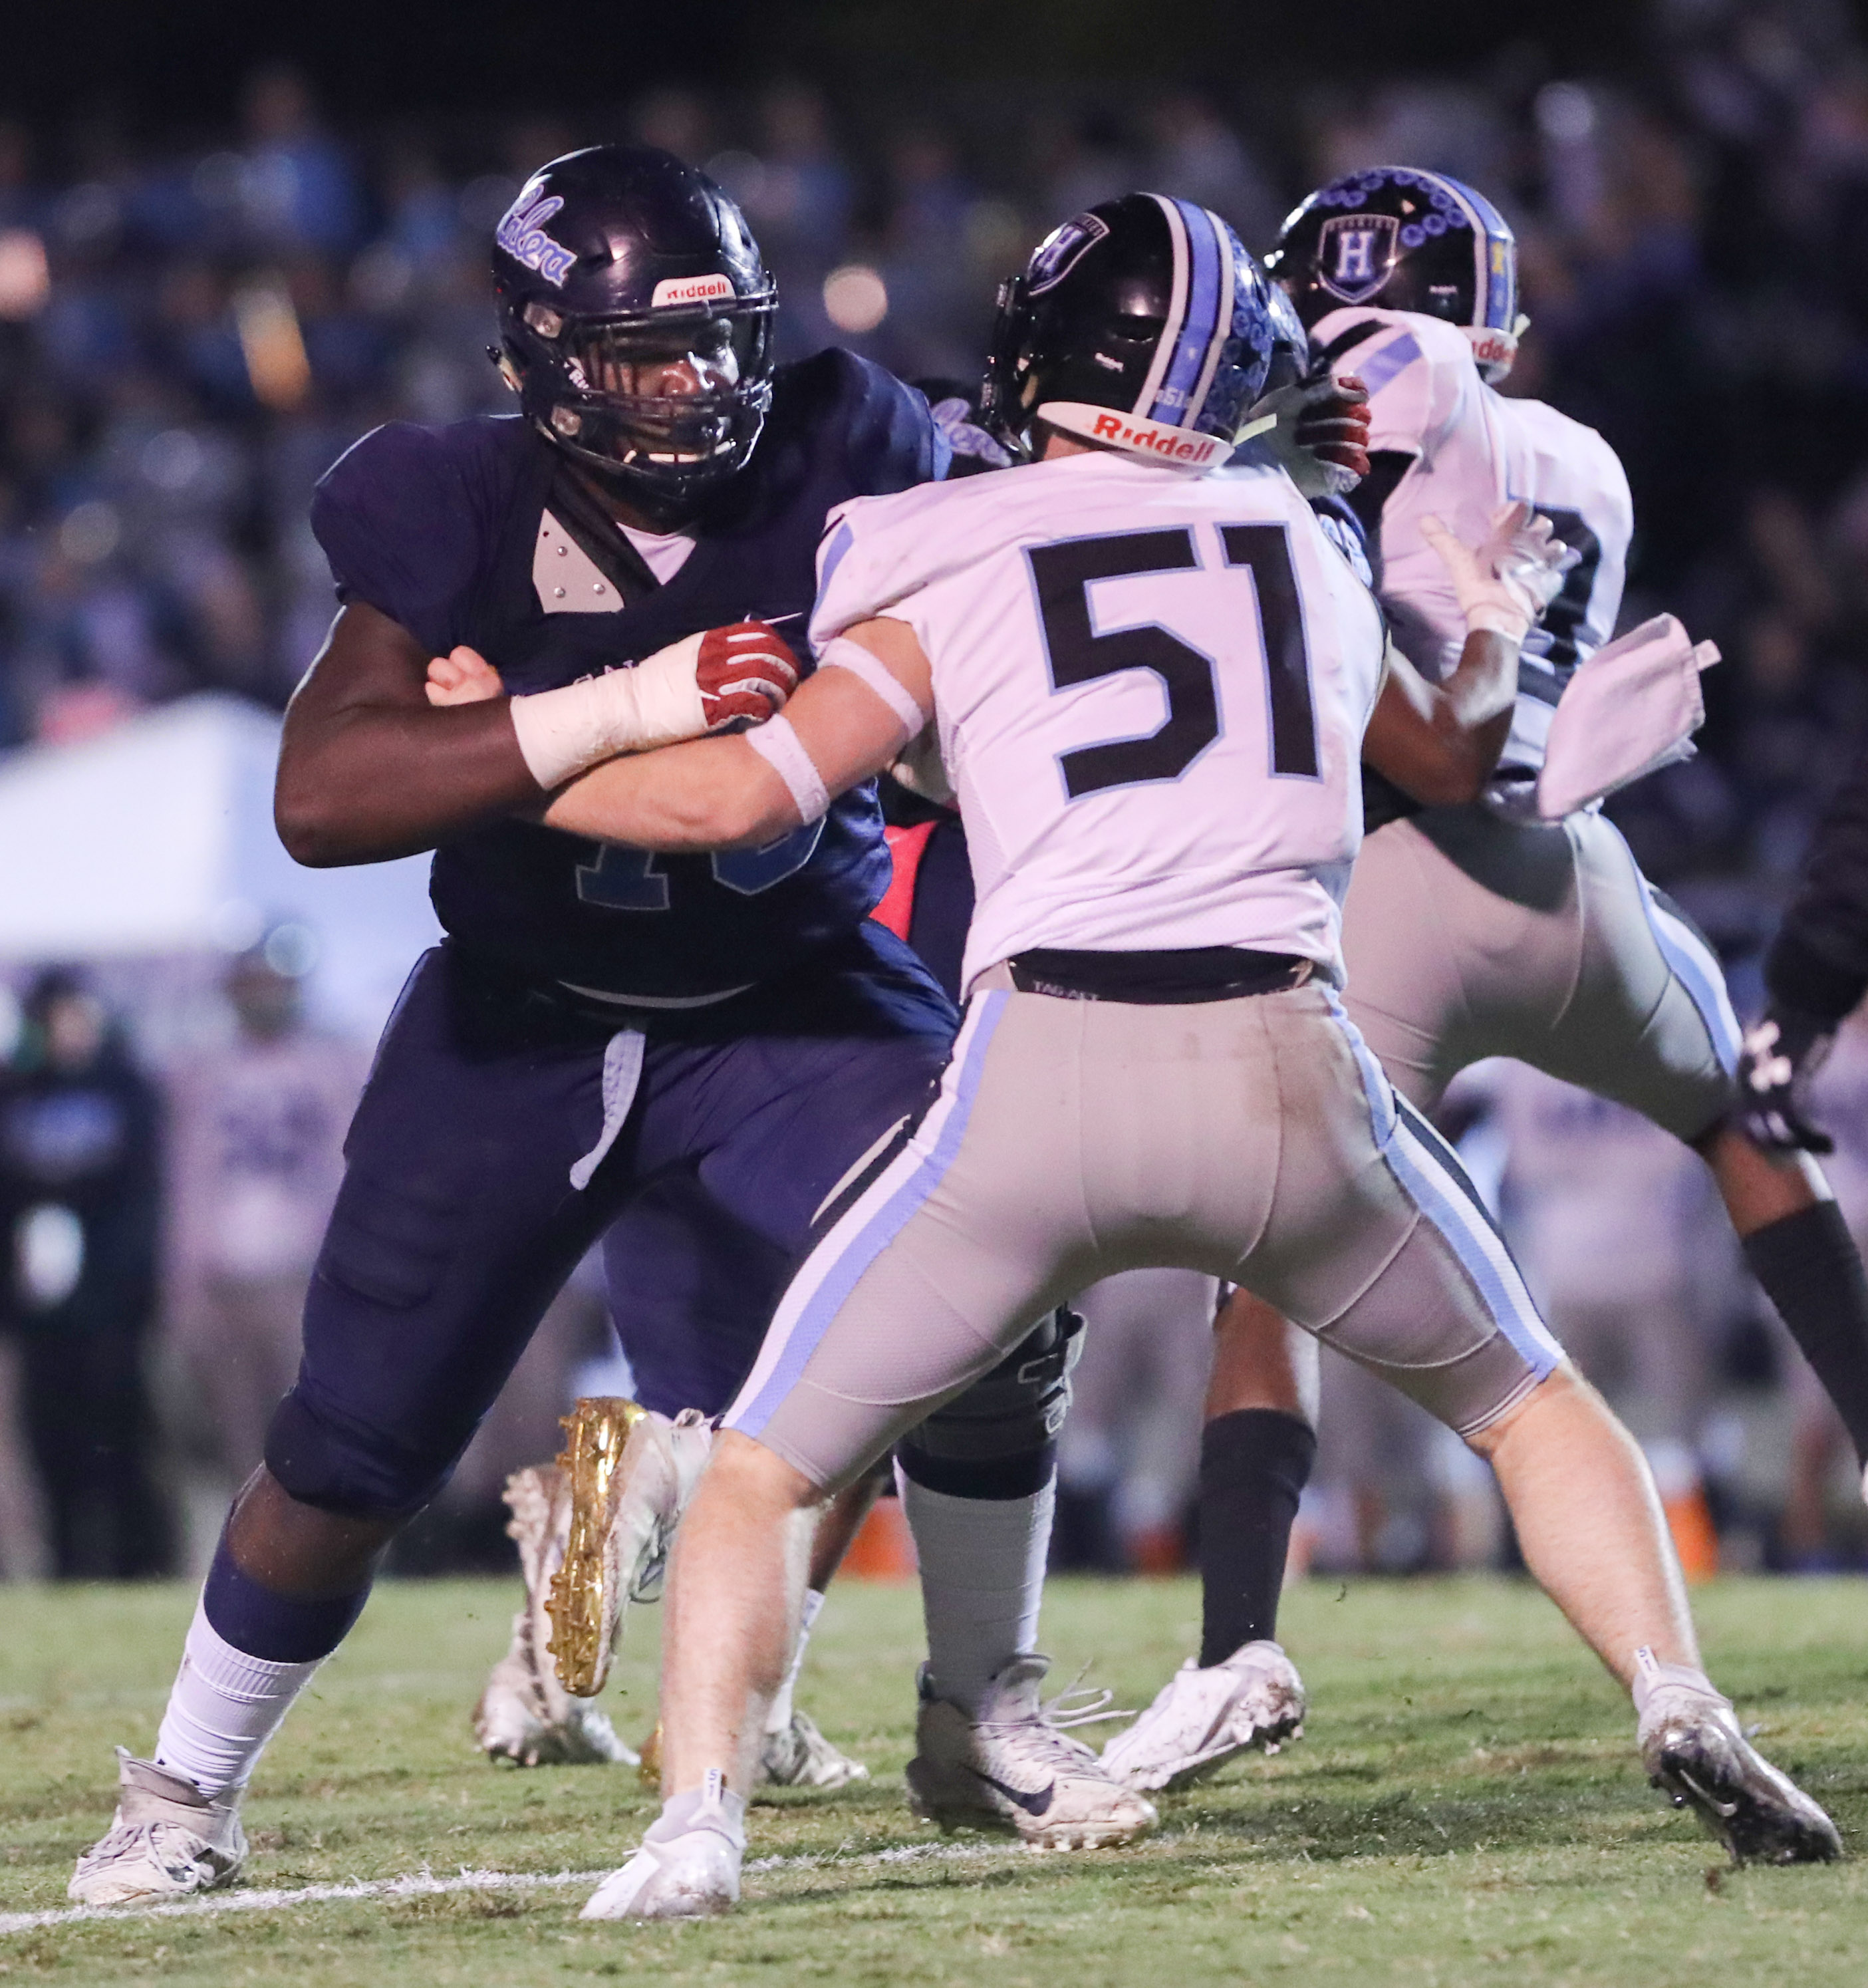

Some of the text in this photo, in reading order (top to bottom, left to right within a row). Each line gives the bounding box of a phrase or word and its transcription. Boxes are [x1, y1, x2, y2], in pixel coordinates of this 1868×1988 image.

[1335, 231, 1375, 279] H
[1093, 413, 1216, 462] Riddell
[1019, 517, 1324, 807] 51
